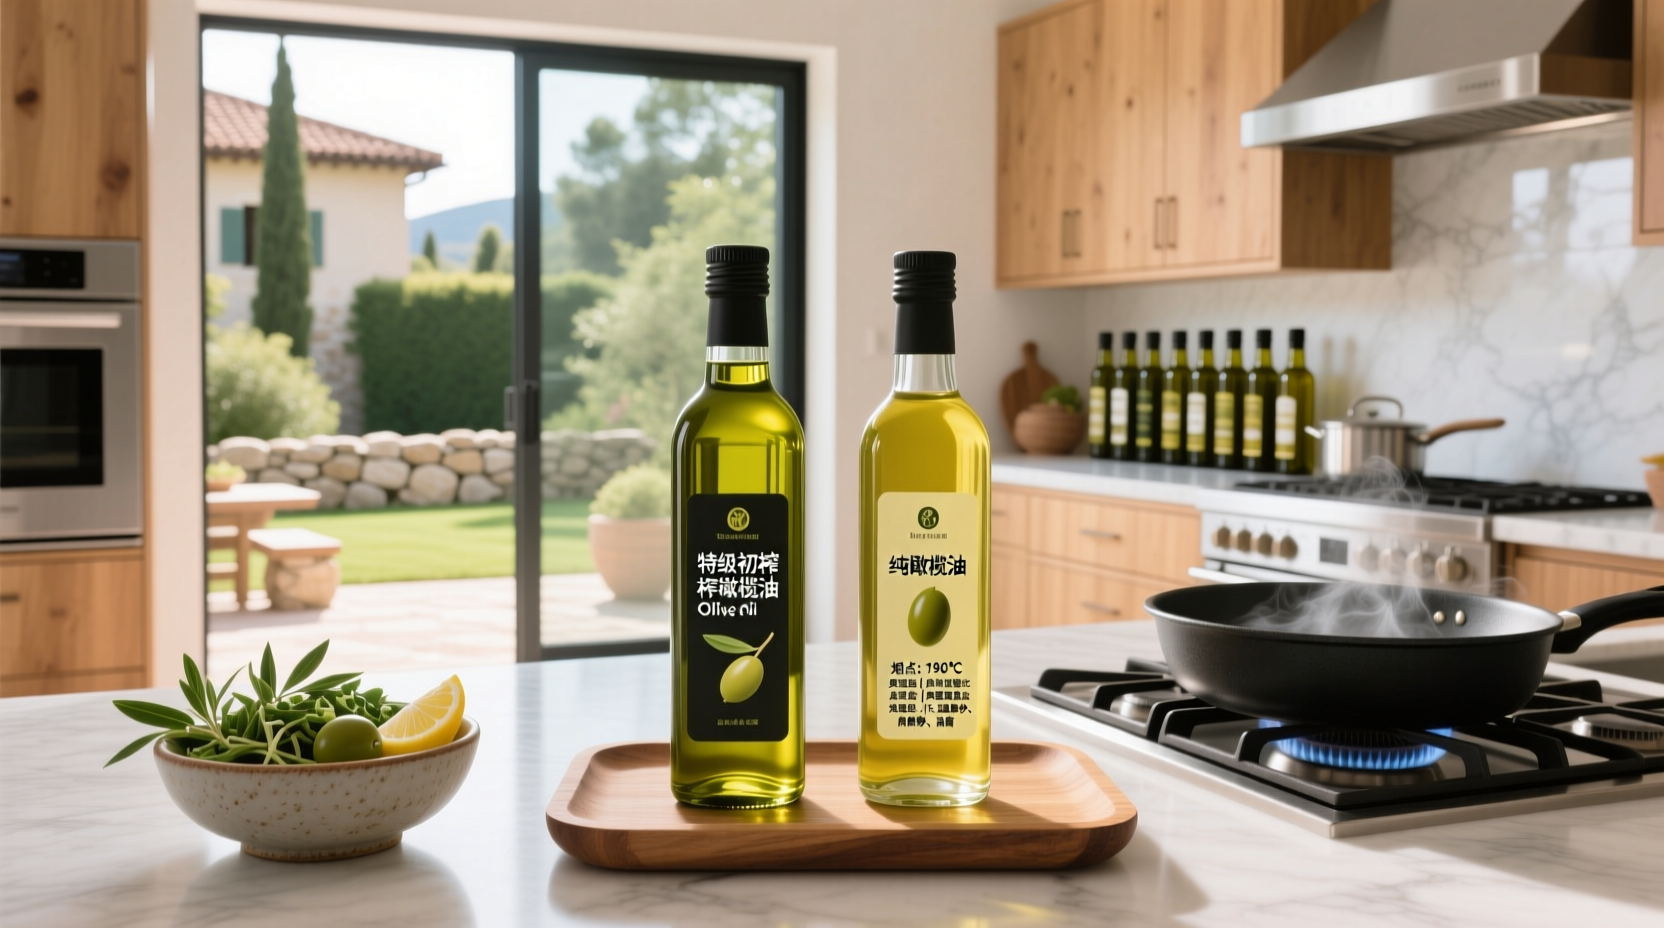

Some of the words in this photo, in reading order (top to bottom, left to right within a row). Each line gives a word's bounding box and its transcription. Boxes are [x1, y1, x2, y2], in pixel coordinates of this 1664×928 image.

[697, 551, 779, 575] 特级初榨
[697, 601, 737, 617] Olive
